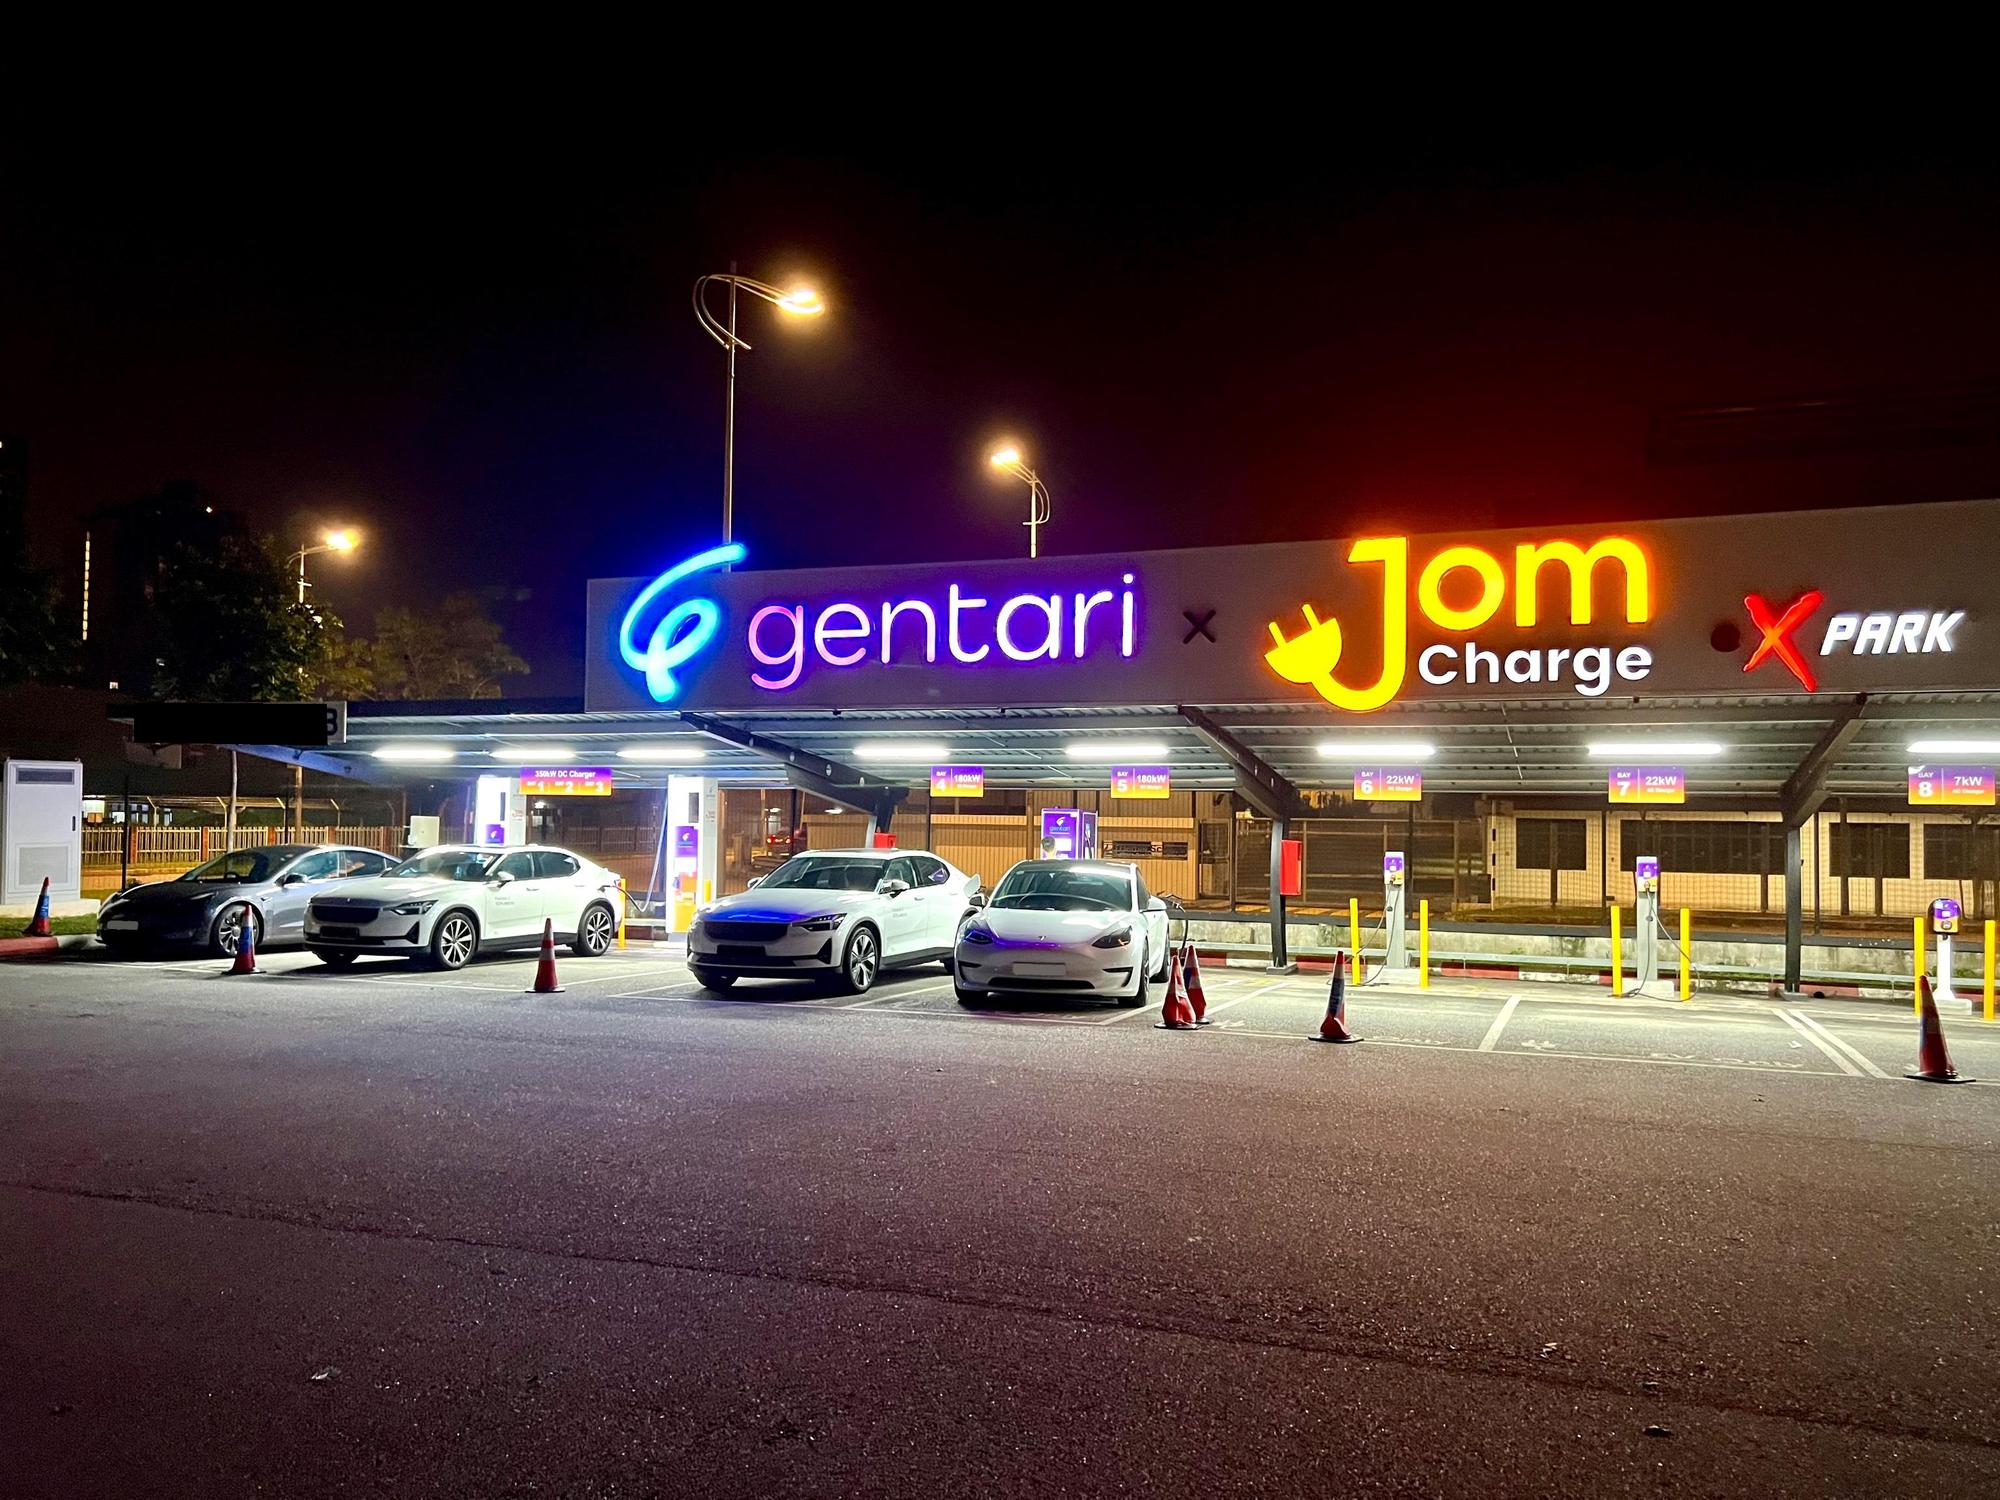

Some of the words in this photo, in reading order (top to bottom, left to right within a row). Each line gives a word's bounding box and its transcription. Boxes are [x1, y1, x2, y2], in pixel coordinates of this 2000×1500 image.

[748, 573, 1135, 690] gentari
[1819, 611, 1965, 656] PARK
[558, 770, 568, 778] DC
[569, 770, 597, 780] Charger
[954, 774, 981, 783] 180kW
[1136, 774, 1167, 783] 180kW
[1386, 775, 1415, 785] 22kW
[1645, 775, 1677, 786] 22kW
[1953, 776, 1983, 786] 7kW
[537, 781, 545, 793] 1
[564, 781, 574, 793] 2
[595, 781, 604, 793] 3
[936, 778, 946, 792] 4
[1117, 779, 1128, 793] 5
[1361, 780, 1373, 795] 6
[1616, 781, 1631, 797] 7
[1918, 781, 1933, 798] 8
